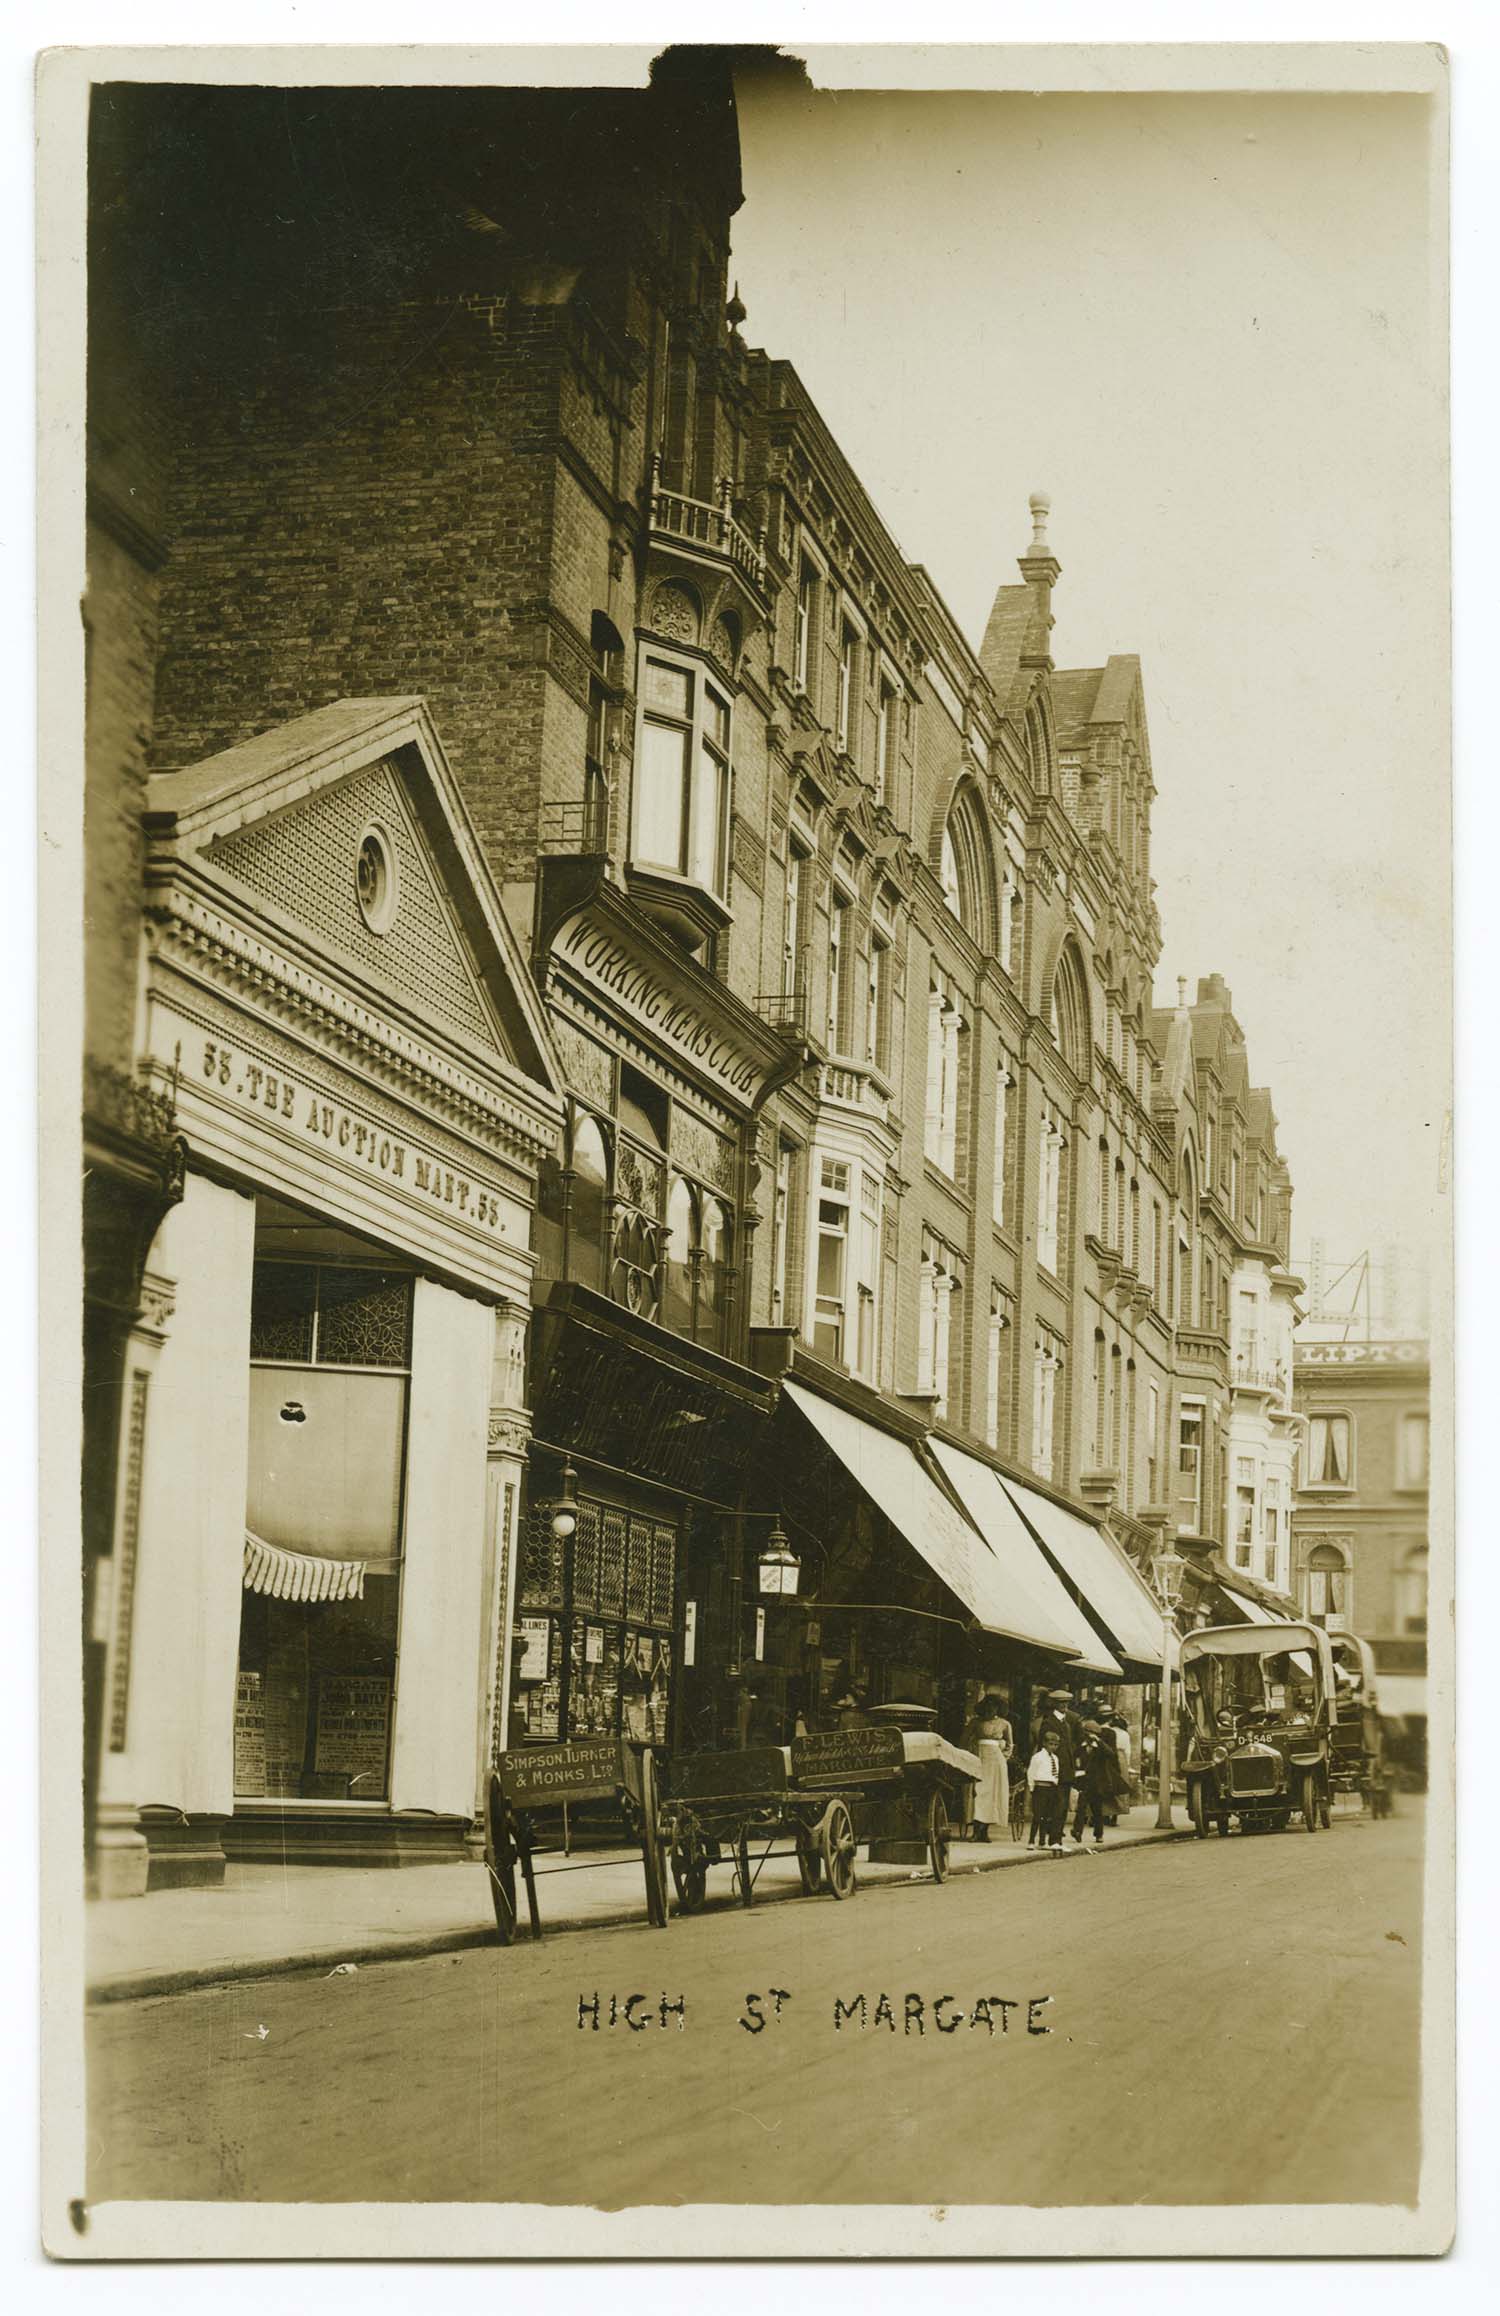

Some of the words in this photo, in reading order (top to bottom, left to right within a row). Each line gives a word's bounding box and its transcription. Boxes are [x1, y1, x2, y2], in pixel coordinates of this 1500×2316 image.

[565, 914, 670, 1019] WORKING
[246, 1064, 295, 1119] THE
[306, 1098, 405, 1178] AUCTION
[516, 1773, 527, 1788] &
